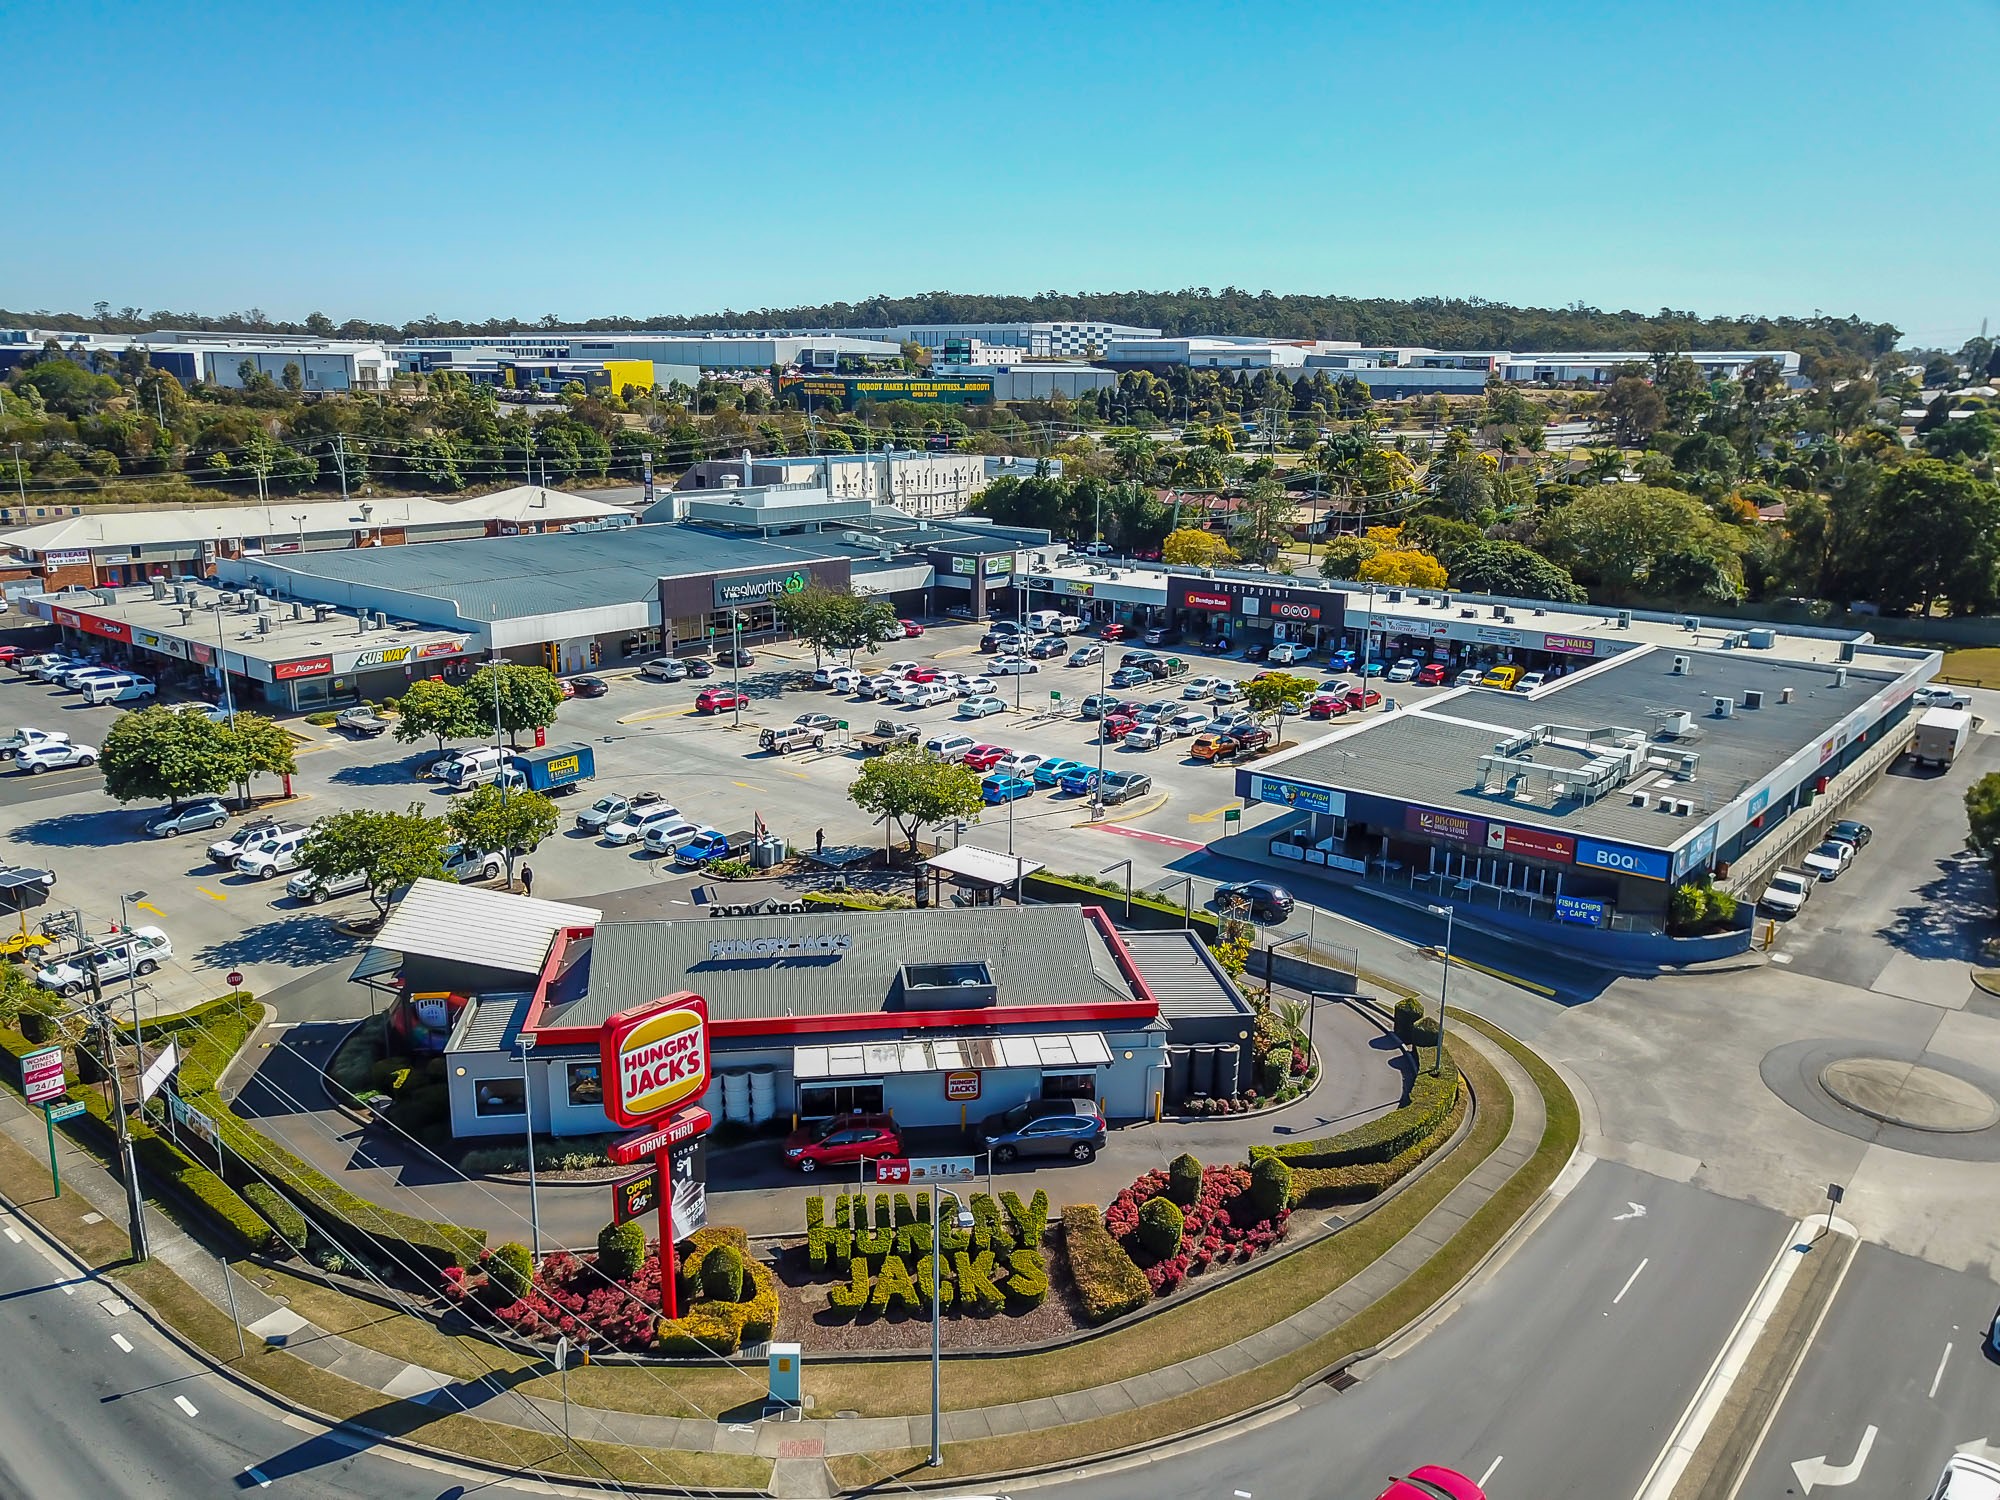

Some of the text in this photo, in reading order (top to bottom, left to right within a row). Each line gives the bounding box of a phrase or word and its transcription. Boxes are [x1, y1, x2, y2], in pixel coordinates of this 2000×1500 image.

[857, 383, 882, 391] NOBODY
[884, 383, 903, 391] MAKES
[905, 383, 909, 391] A
[910, 383, 931, 391] BETTER
[1214, 583, 1290, 598] WESTPOINT
[1282, 606, 1309, 616] BWS
[1566, 639, 1593, 649] NAILS
[358, 646, 411, 667] SUBWAY
[296, 662, 329, 673] Pizza Hut
[549, 758, 573, 770] FIRST
[1263, 783, 1278, 791] LUV
[1300, 790, 1311, 798] MY
[1312, 793, 1329, 801] FISH
[1434, 823, 1469, 836] DRUG STORES
[1435, 815, 1469, 829] DISCOUNT
[1596, 850, 1634, 869] BOQ
[1558, 898, 1601, 912] FISH & CHIPS
[1569, 909, 1588, 919] CAFE
[709, 934, 852, 955] HUNGRY JACK'S
[228, 975, 243, 983] STOP
[26, 1051, 60, 1066] WOMEN'S
[624, 1030, 699, 1073] HUNGRY
[31, 1059, 56, 1070] FITNESS
[626, 1050, 700, 1098] JACK'S
[35, 1079, 57, 1092] 24/7
[640, 1122, 694, 1156] DRIVE THRU
[673, 1142, 699, 1158] LARGE
[676, 1156, 692, 1177] $1
[626, 1176, 652, 1195] OPEN
[831, 1250, 1049, 1310] JACKS
